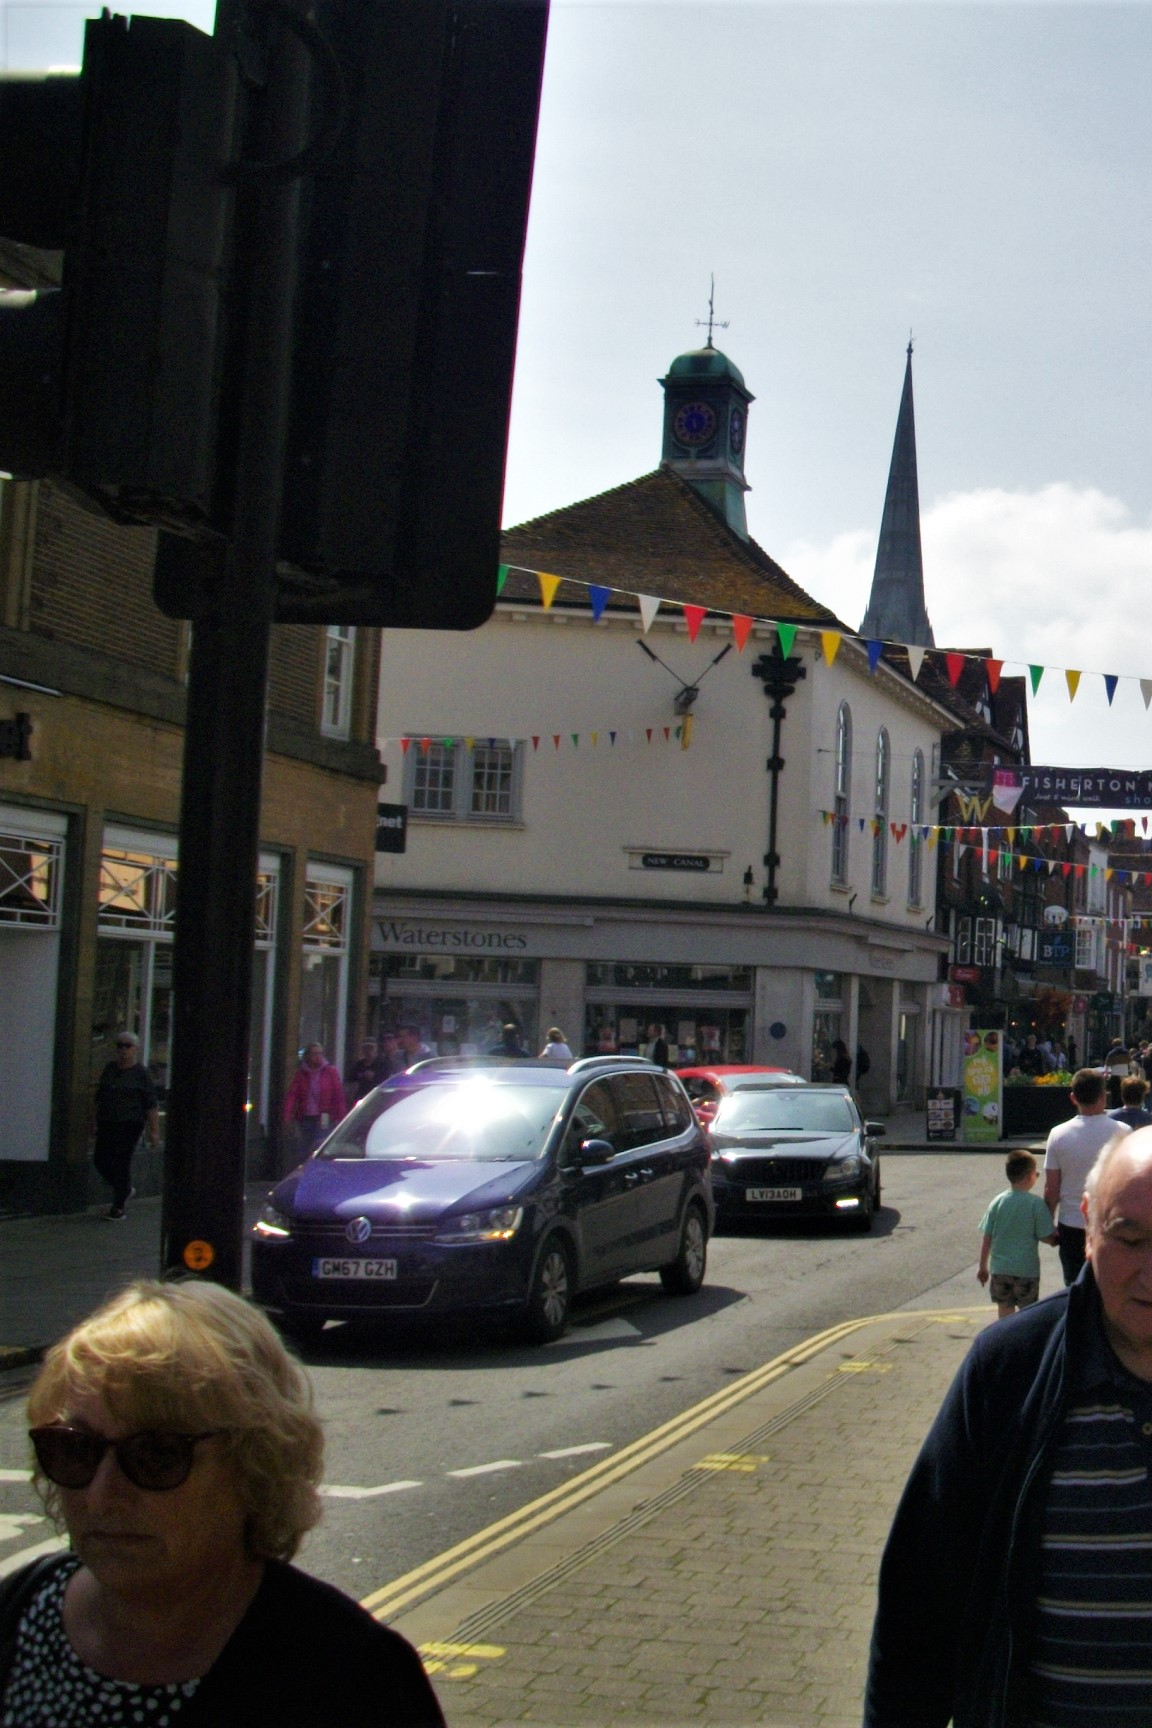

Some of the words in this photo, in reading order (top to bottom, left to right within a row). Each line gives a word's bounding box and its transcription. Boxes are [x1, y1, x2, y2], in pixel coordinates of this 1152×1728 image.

[1022, 777, 1136, 791] FISHERTON
[648, 857, 667, 865] NEW
[673, 858, 704, 867] CANAL
[378, 921, 528, 949] Waterstones
[322, 1260, 360, 1276] GM67
[364, 1260, 395, 1276] GZH
